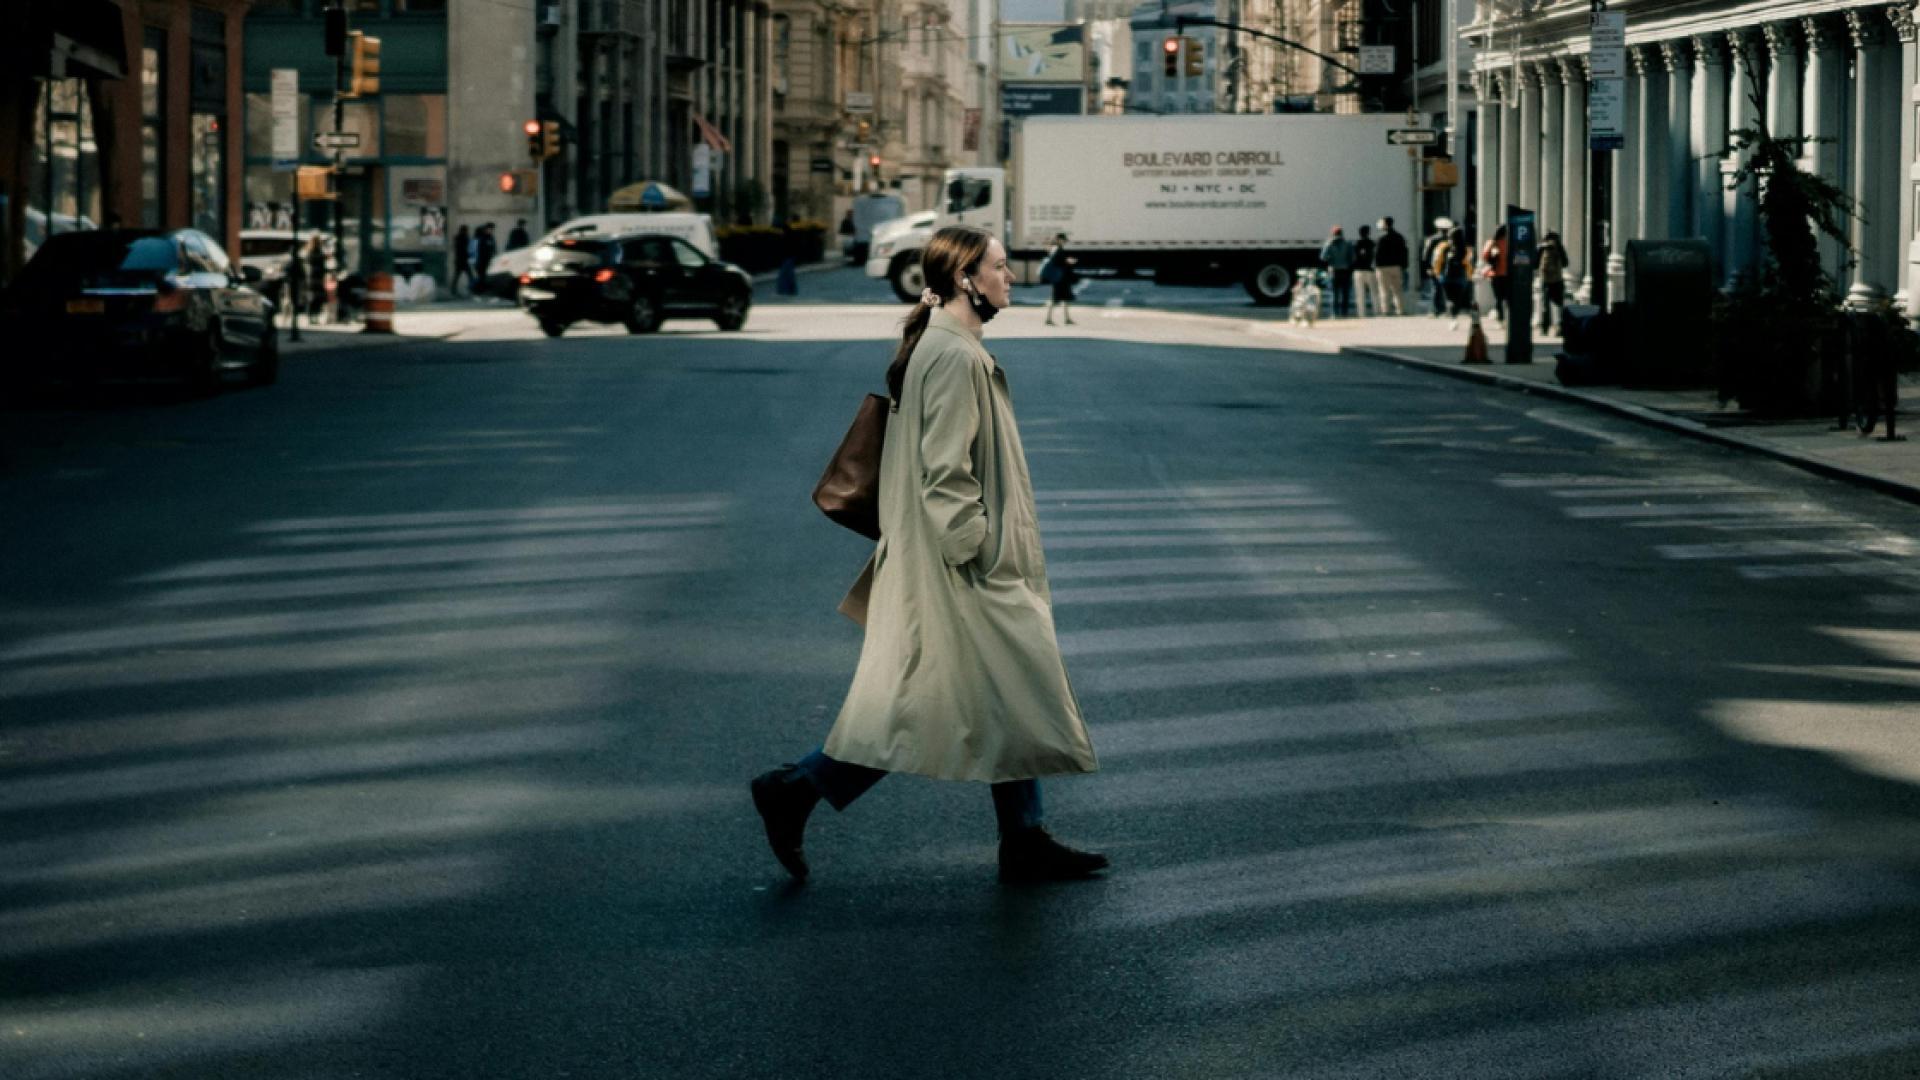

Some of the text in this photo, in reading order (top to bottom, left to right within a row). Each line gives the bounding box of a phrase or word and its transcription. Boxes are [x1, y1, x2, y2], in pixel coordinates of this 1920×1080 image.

[1123, 151, 1284, 167] BOULEVARD CARROLL
[1160, 184, 1256, 193] NJ NYC DC
[1517, 225, 1528, 240] P
